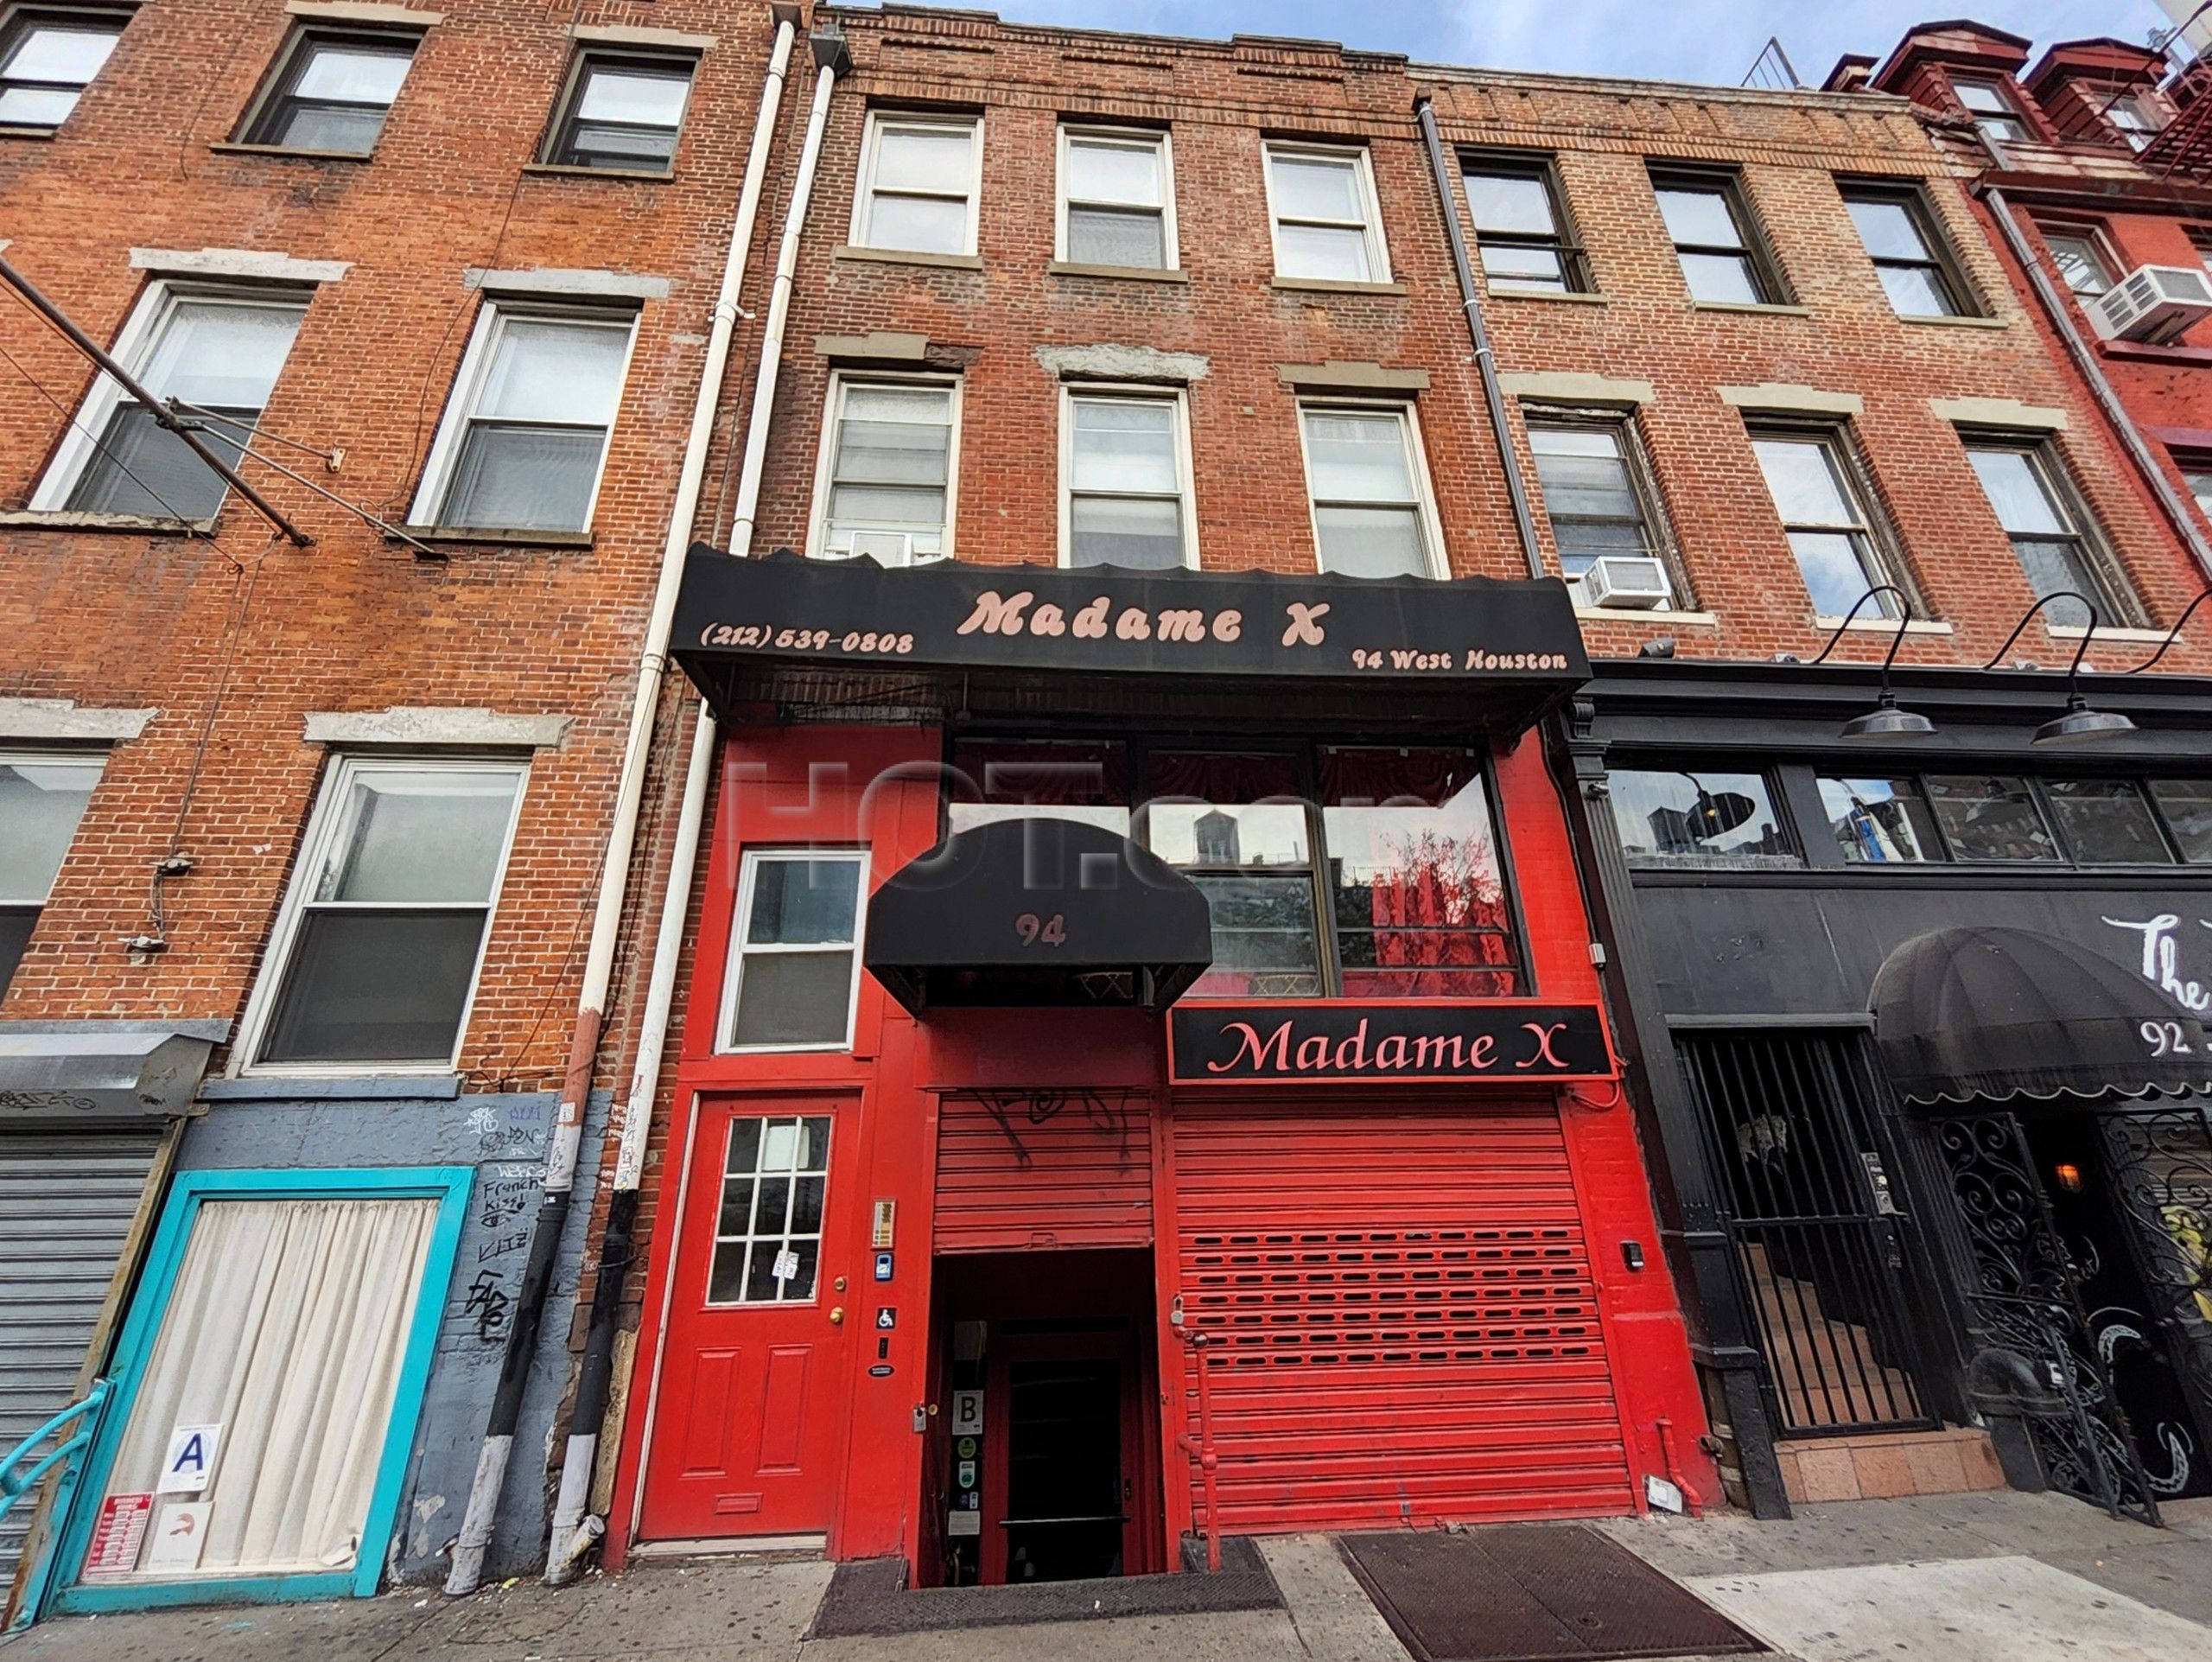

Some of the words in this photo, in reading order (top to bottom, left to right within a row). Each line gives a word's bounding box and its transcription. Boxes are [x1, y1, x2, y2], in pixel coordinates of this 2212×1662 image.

[956, 590, 1243, 643] Madame
[1281, 602, 1331, 646] X
[1351, 648, 1383, 671] 94
[1389, 649, 1452, 671] West
[1465, 649, 1568, 671] Houston
[1015, 913, 1066, 947] 94
[2101, 914, 2211, 1011] The
[1206, 1017, 1499, 1073] Madame
[1515, 1022, 1570, 1068] X
[2139, 1021, 2193, 1057] 92
[171, 1432, 205, 1473] A
